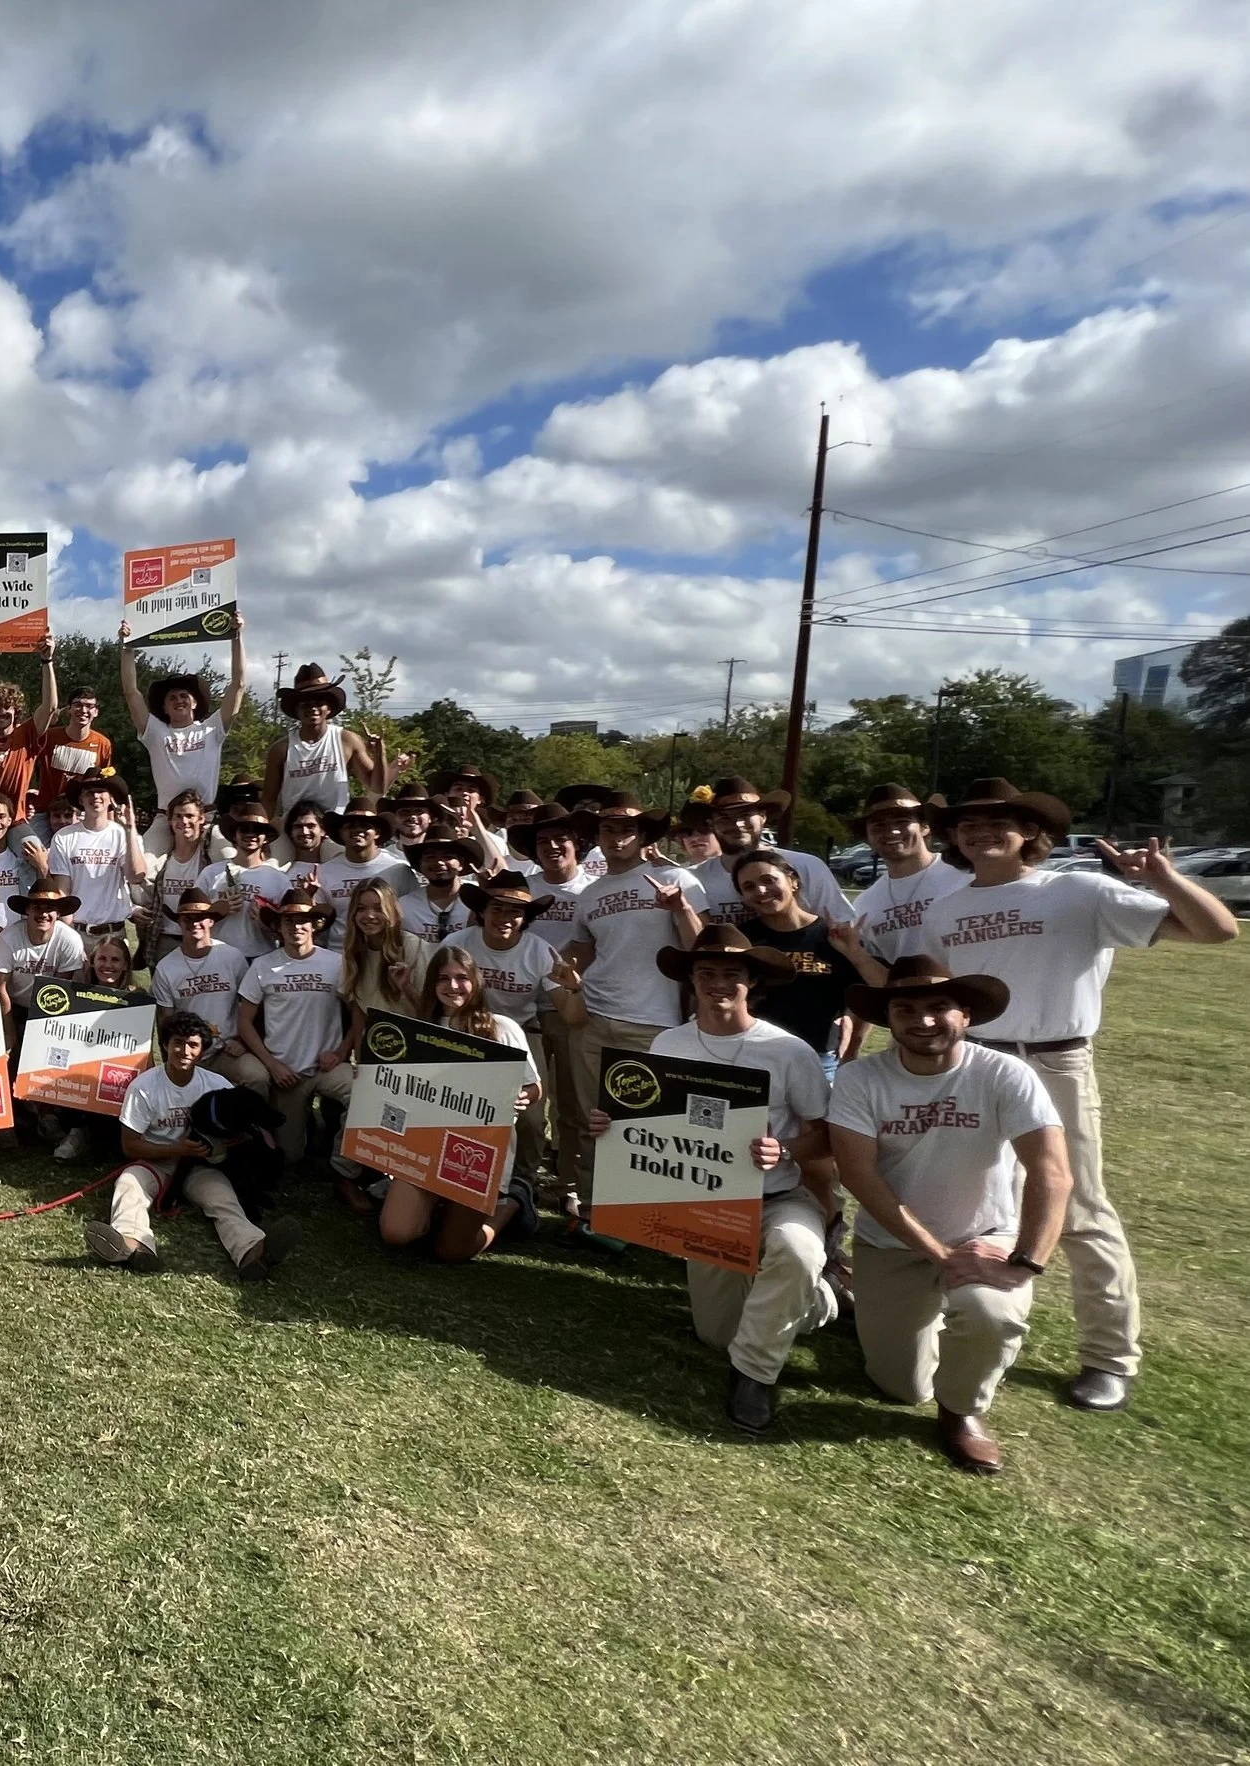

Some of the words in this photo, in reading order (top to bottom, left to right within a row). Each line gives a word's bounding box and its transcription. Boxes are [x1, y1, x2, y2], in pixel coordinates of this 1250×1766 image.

[3, 580, 33, 591] Wide
[12, 597, 29, 609] Up
[136, 599, 148, 615] Up
[151, 597, 172, 613] Hold
[175, 597, 198, 610] Wide
[201, 592, 221, 607] City
[79, 848, 111, 856] TEXAS
[70, 857, 118, 865] WRANGLERS
[584, 861, 607, 869] XAS
[165, 879, 194, 887] TEXAS
[597, 889, 639, 907] TEXAS
[587, 899, 655, 921] WRANGLERS
[883, 898, 934, 920] TEXAS
[955, 909, 1021, 931] TEXAS
[422, 923, 463, 933] TEAS
[941, 921, 1044, 948] WRANGLERS
[186, 973, 219, 987] TEXAS
[284, 974, 322, 983] TEXAS
[484, 979, 533, 993] NGLERS
[178, 982, 230, 997] WRANGLERS
[272, 983, 334, 993] WRANGLERS
[44, 1019, 65, 1040] City
[69, 1023, 94, 1043] Wide
[97, 1028, 121, 1049] Hold
[123, 1034, 137, 1054] Up
[374, 1064, 402, 1095] City
[405, 1073, 437, 1104] Wide
[440, 1086, 473, 1116] Hold
[476, 1097, 496, 1125] Up
[881, 1111, 980, 1135] WRANLERS
[623, 1127, 669, 1153] City
[671, 1136, 734, 1164] Wide
[629, 1153, 684, 1181] Hold
[691, 1166, 723, 1191] Up
